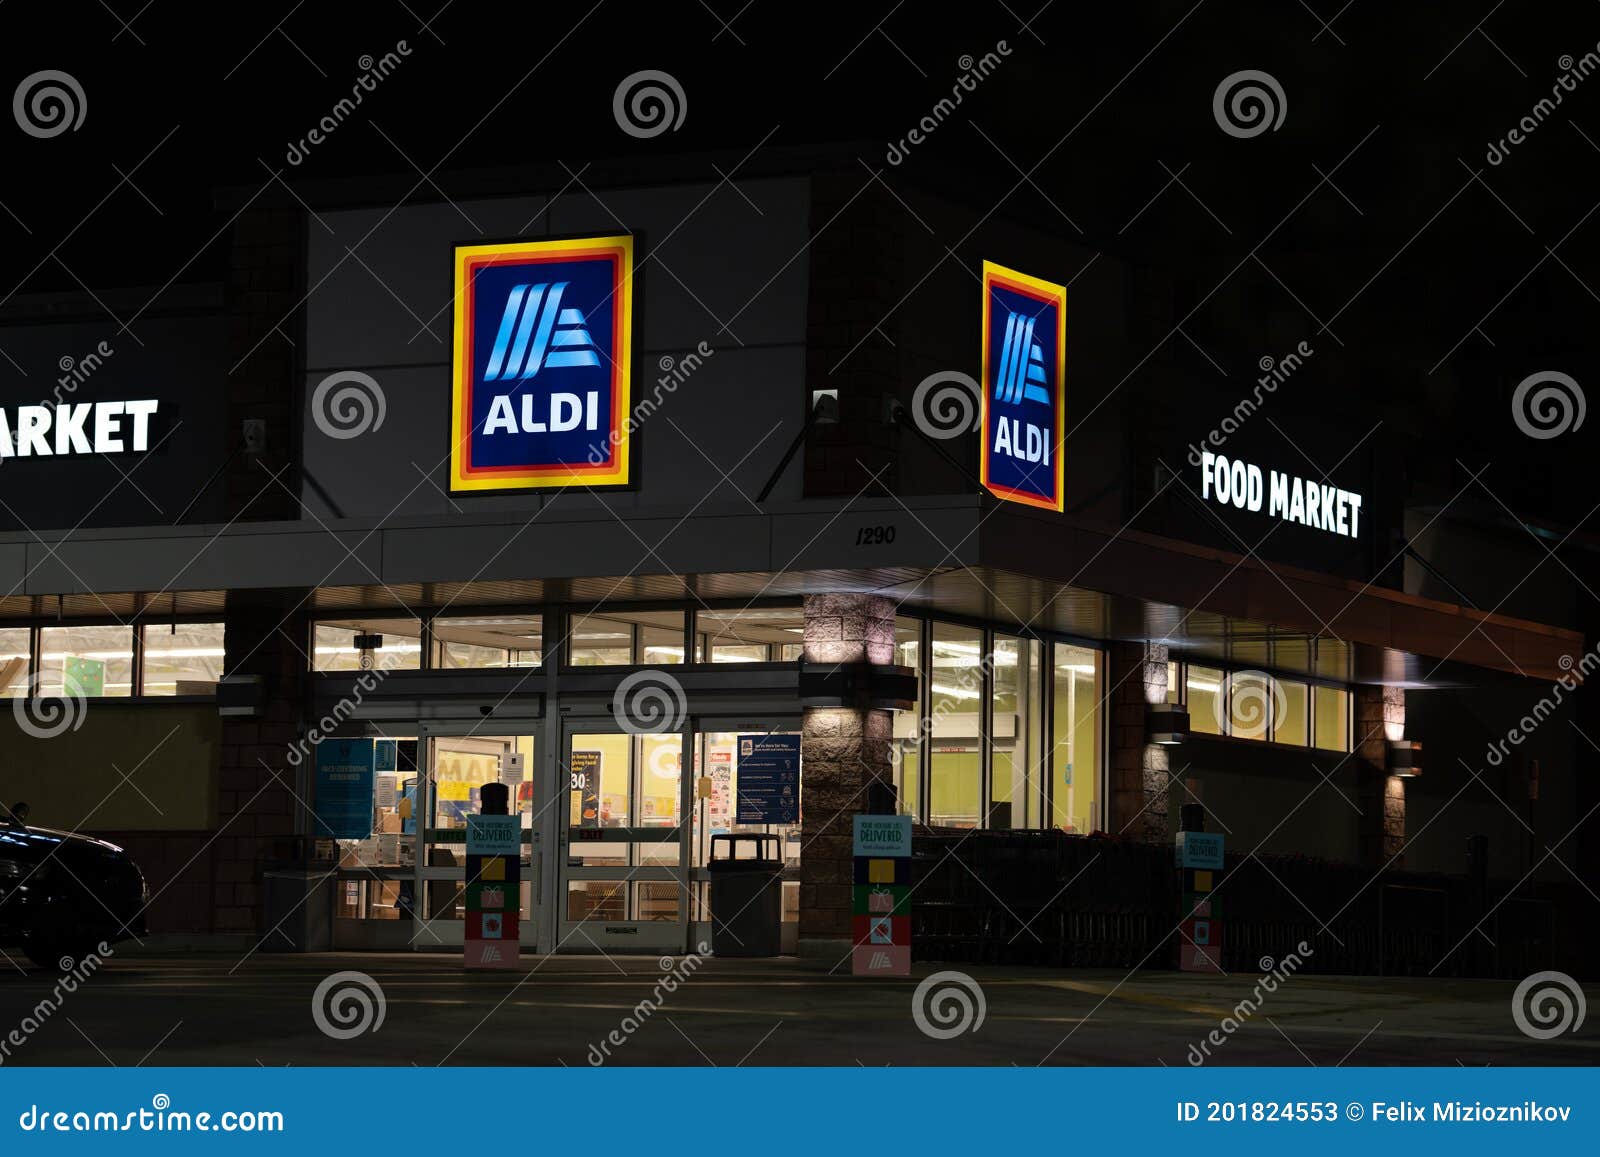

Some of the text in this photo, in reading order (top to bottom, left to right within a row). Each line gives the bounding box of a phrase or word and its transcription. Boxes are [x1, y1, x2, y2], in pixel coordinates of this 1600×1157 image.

[482, 391, 599, 435] ALDI
[994, 415, 1050, 467] ALDI
[1202, 451, 1362, 538] FOOD MARKET
[856, 526, 896, 546] 1290
